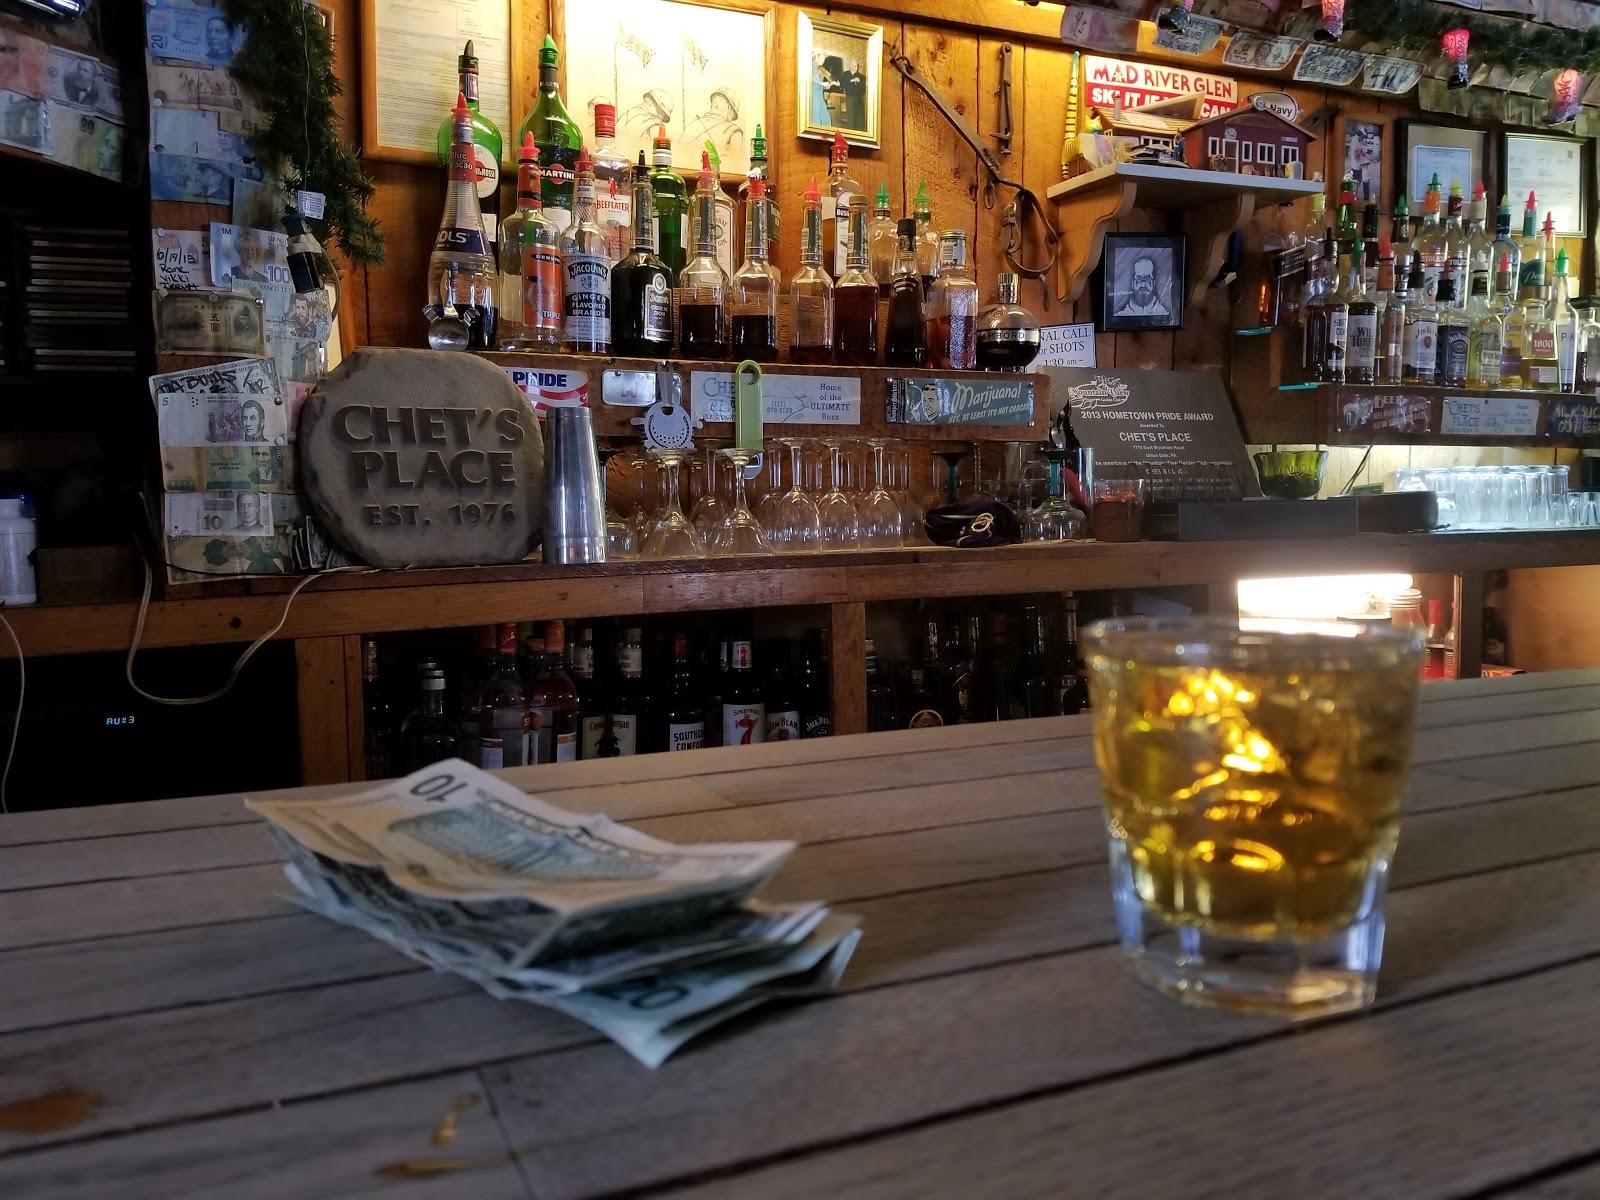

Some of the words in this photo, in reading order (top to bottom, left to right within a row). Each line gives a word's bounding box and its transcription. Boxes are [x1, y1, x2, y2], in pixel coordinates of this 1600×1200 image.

[1093, 63, 1139, 85] MAD
[1144, 68, 1190, 92] RIVER
[1194, 77, 1233, 98] GLEN
[1124, 91, 1142, 107] IT
[1200, 101, 1232, 118] CAN
[1268, 103, 1293, 116] Navy
[540, 169, 575, 180] MARTINI
[596, 200, 630, 213] BEEFEATER
[437, 230, 468, 244] OLS
[571, 294, 606, 303] GINGER
[982, 331, 1025, 341] AMBORD
[1041, 329, 1060, 342] NAL
[1062, 327, 1091, 340] CALL
[1357, 327, 1374, 337] WIL
[1049, 340, 1085, 354] SHOTS
[1533, 339, 1553, 349] 1800
[512, 371, 567, 388] PRIDE
[703, 377, 736, 398] CHE
[820, 383, 842, 391] Home
[1068, 386, 1108, 399] Mountain
[950, 382, 1022, 414] Marijuana!
[711, 400, 736, 412] PLA
[811, 403, 851, 411] ULTIMATE
[822, 413, 840, 421] Buzz
[962, 413, 969, 421] AT
[970, 411, 986, 420] LEAST
[1080, 411, 1101, 420] 2013
[1102, 411, 1155, 421] HOMETOWN
[1156, 412, 1182, 421] PRIDE
[1184, 412, 1214, 423] AWARD
[1452, 415, 1480, 427] PLACE
[332, 405, 524, 447] CHET'S
[1119, 432, 1157, 442] CHET'S
[1158, 432, 1192, 442] PLACE
[350, 450, 517, 489] PLACE
[362, 504, 432, 528] EST.
[449, 503, 516, 526] 1976
[203, 515, 223, 530] 10
[735, 717, 759, 745] 7
[768, 720, 780, 732] JIM
[673, 729, 704, 743] SOUTHE
[677, 742, 704, 752] COMFO
[409, 773, 466, 803] 10
